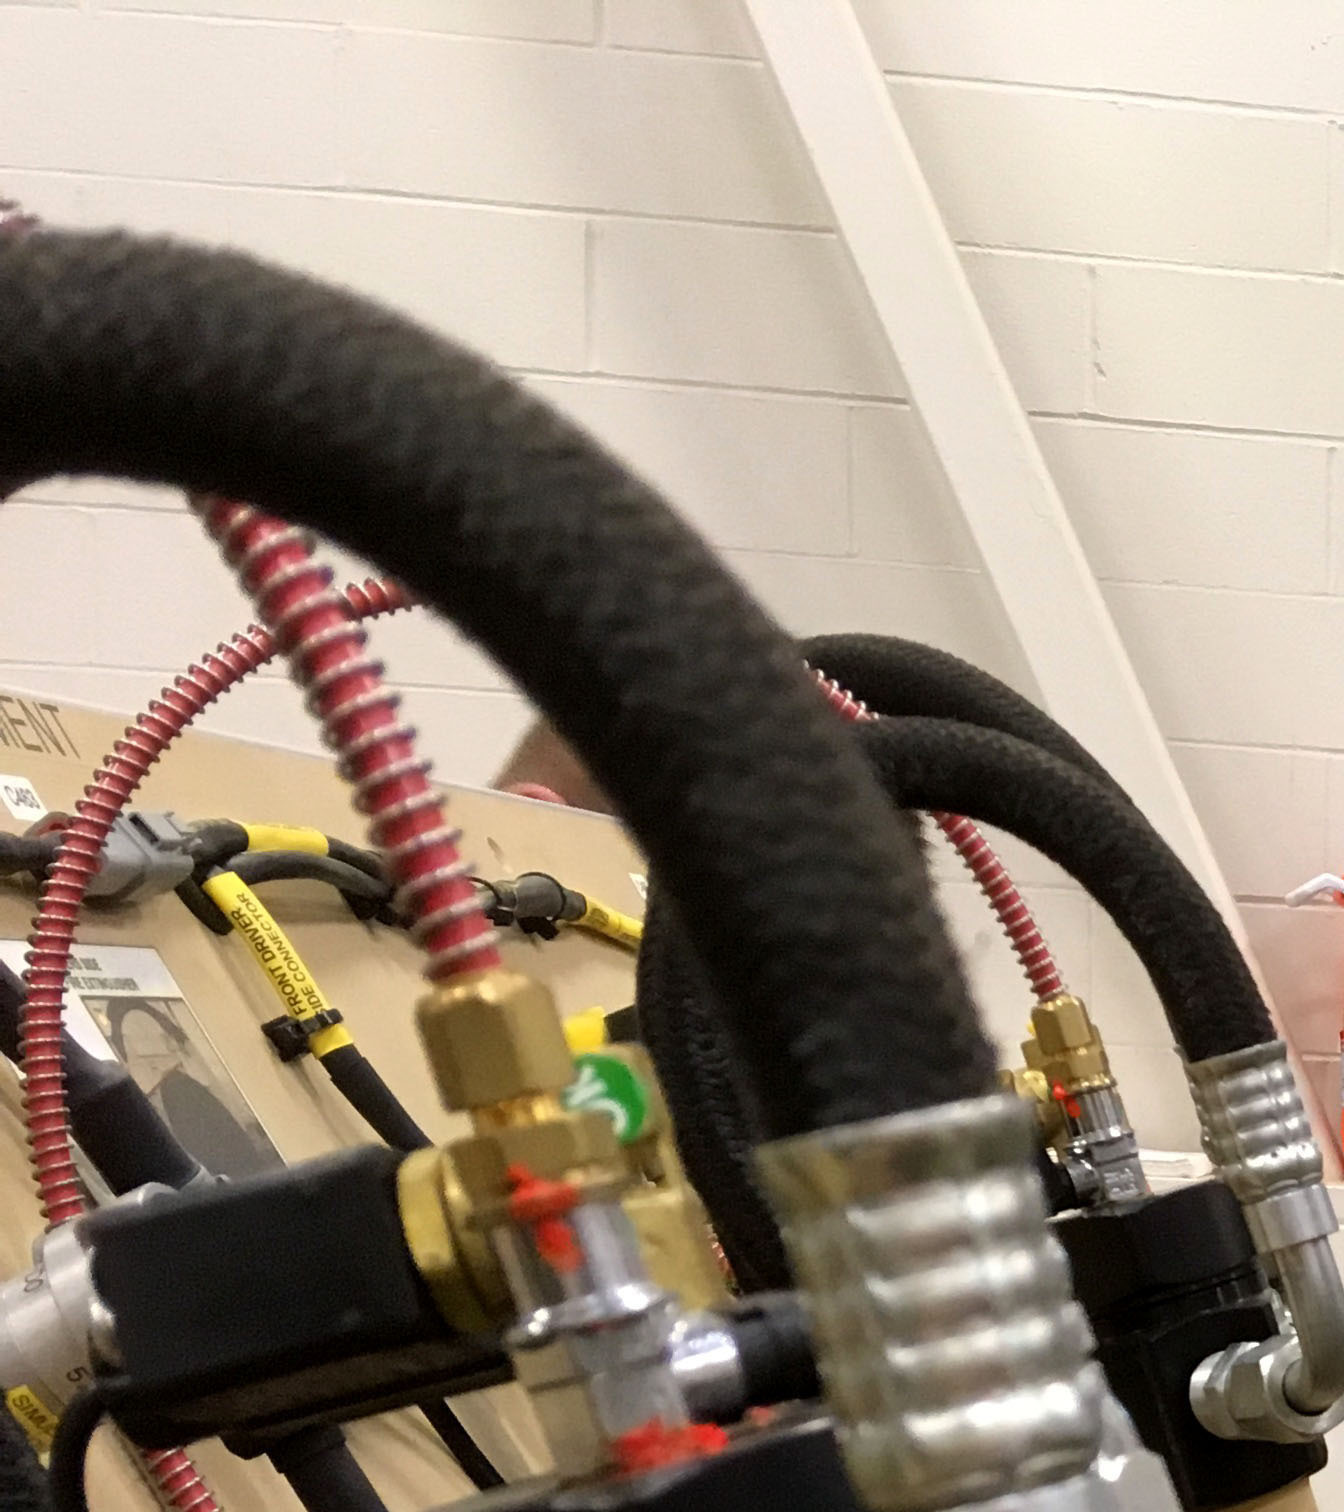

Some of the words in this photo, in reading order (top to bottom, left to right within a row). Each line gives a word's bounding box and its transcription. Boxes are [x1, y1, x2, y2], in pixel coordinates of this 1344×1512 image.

[230, 907, 276, 963] DRIVER
[236, 892, 306, 983] CONNECTOR
[268, 966, 307, 1017] FRONT
